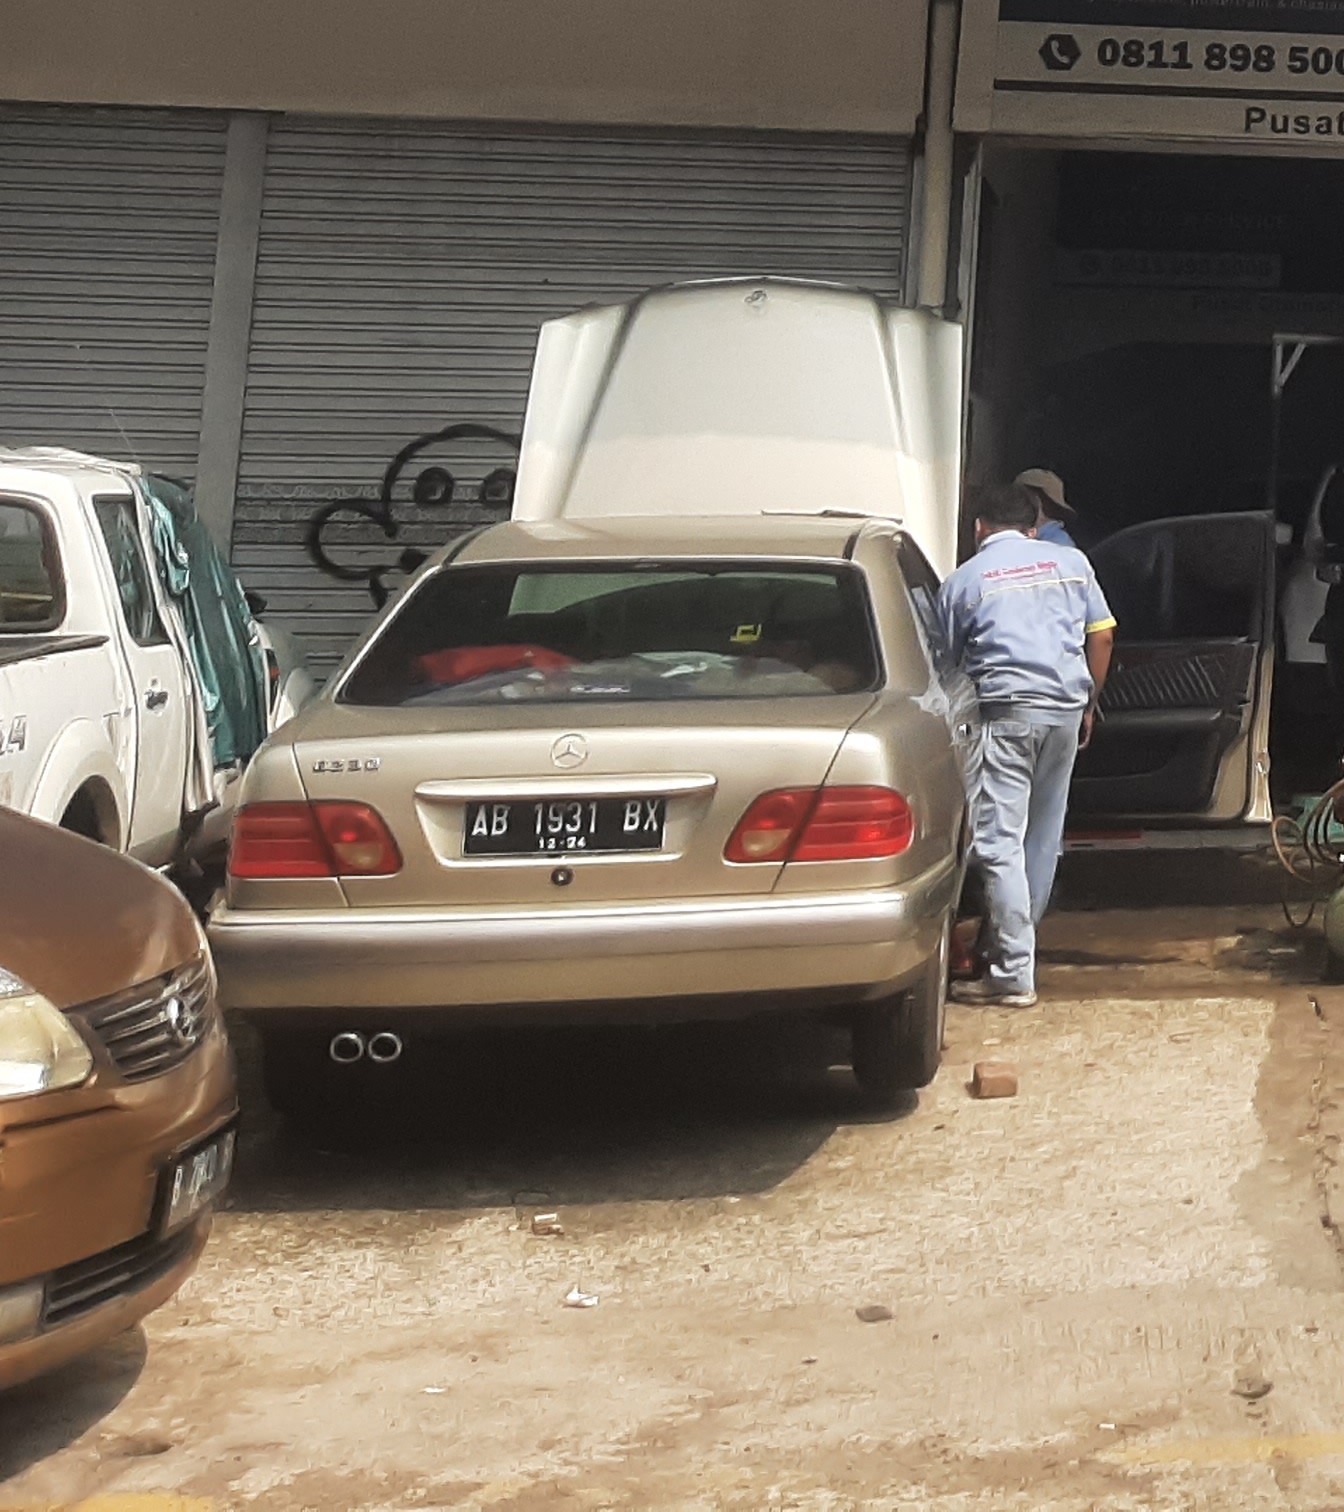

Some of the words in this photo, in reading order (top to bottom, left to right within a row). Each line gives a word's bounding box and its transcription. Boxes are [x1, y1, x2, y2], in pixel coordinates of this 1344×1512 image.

[1097, 38, 1193, 69] 0811
[1204, 42, 1276, 73] 898
[471, 803, 512, 836] AB
[534, 800, 598, 835] 1931
[622, 798, 661, 832] BX
